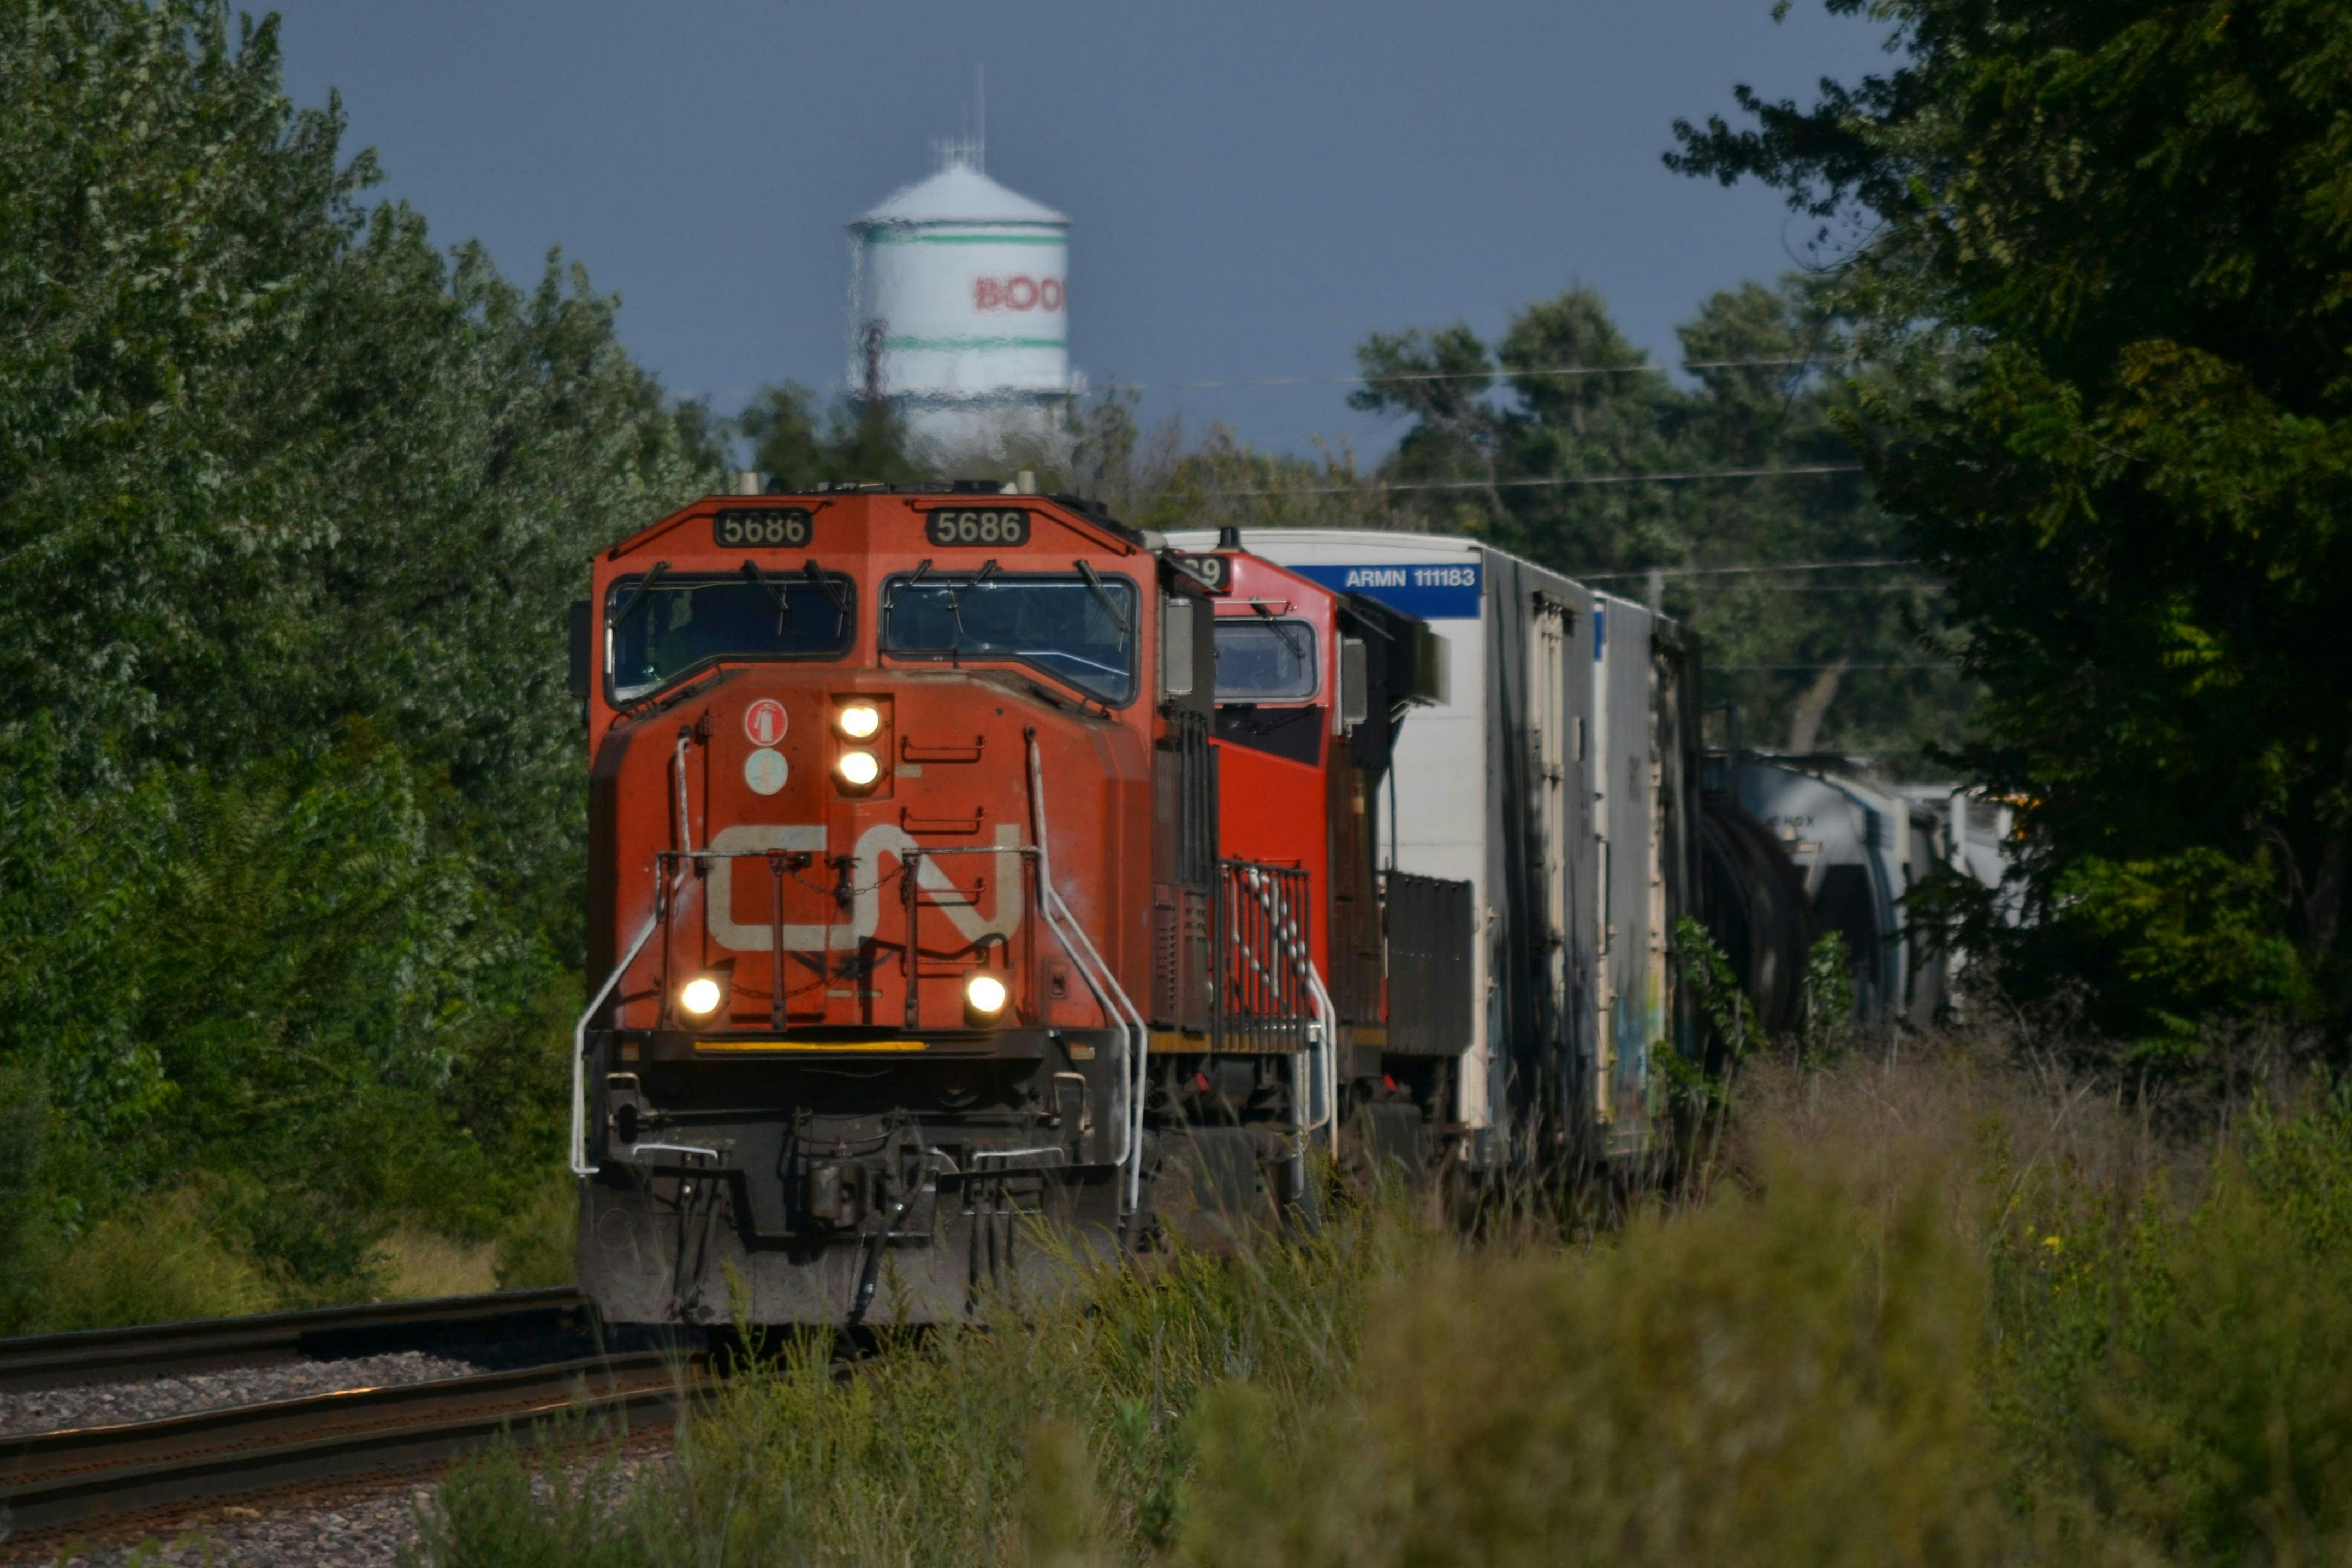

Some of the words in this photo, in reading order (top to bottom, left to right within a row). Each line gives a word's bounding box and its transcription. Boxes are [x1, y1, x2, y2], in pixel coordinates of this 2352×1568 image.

[975, 276, 1067, 311] BOO
[724, 512, 805, 543] 5686
[937, 512, 1021, 542] 5686
[1346, 571, 1406, 587] ARMN
[1413, 569, 1475, 586] 111183
[709, 824, 1023, 951] CN
